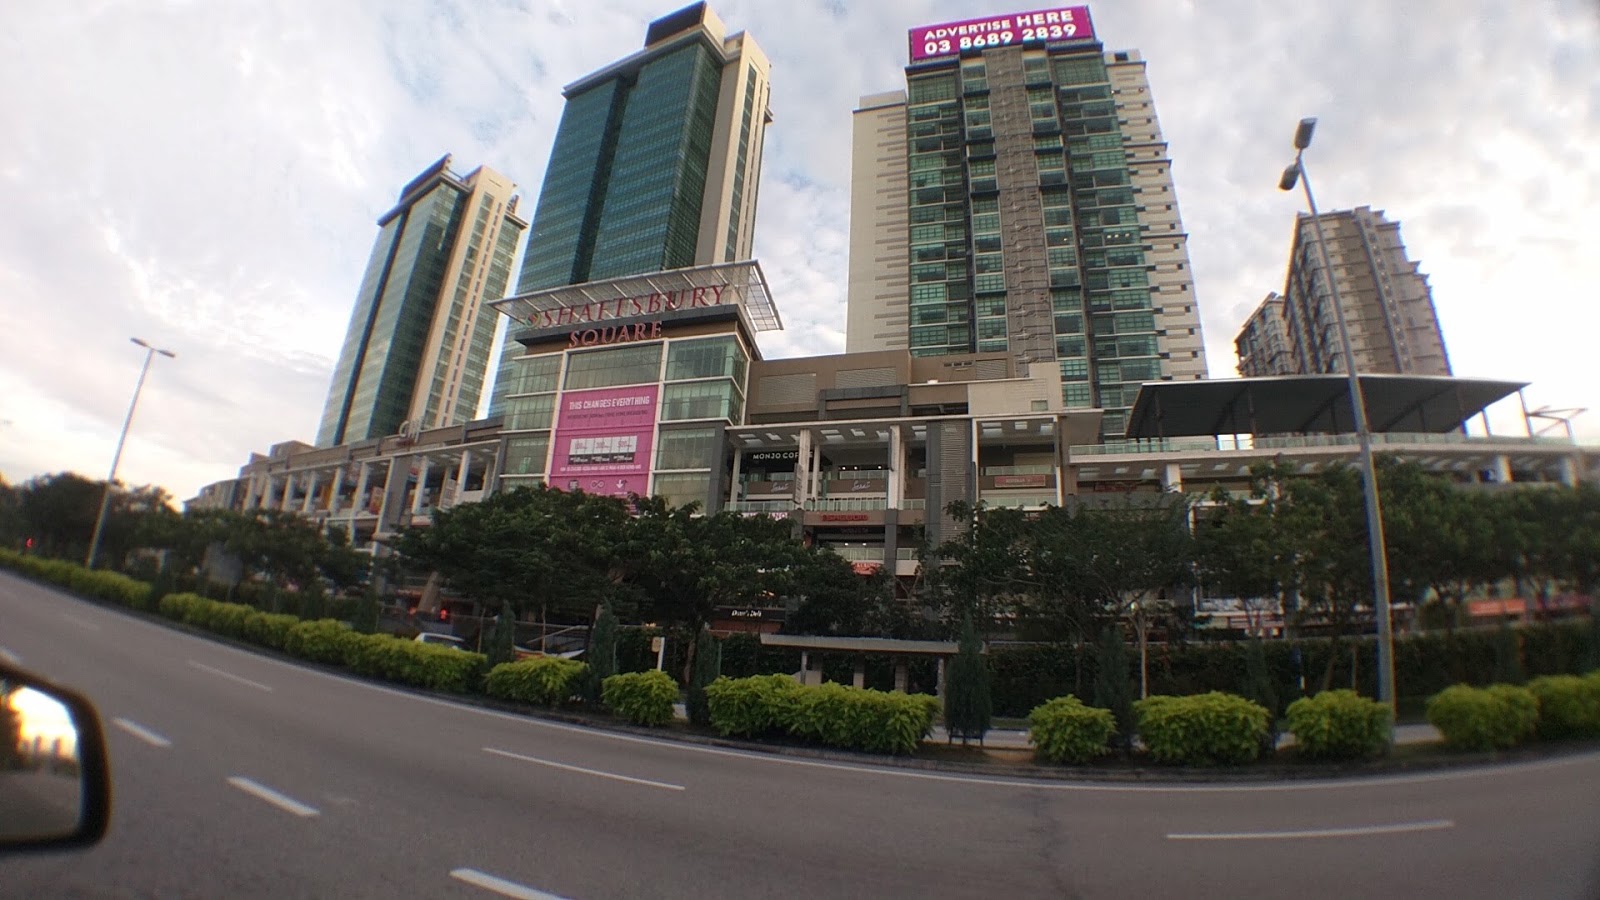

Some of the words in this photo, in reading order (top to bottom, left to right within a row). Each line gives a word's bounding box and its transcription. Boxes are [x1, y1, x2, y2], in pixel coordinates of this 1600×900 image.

[924, 20, 1011, 40] ADVERTISE
[1016, 9, 1074, 28] HERE
[924, 39, 951, 55] 03
[960, 31, 1013, 49] 8689
[1022, 23, 1077, 42] 2839
[542, 284, 728, 328] SHAFTSBURY
[569, 321, 662, 349] SQUARE
[569, 401, 582, 410] THIS
[583, 398, 612, 409] CHANGES
[612, 396, 650, 407] EVERYTHING
[752, 452, 781, 460] MONJO
